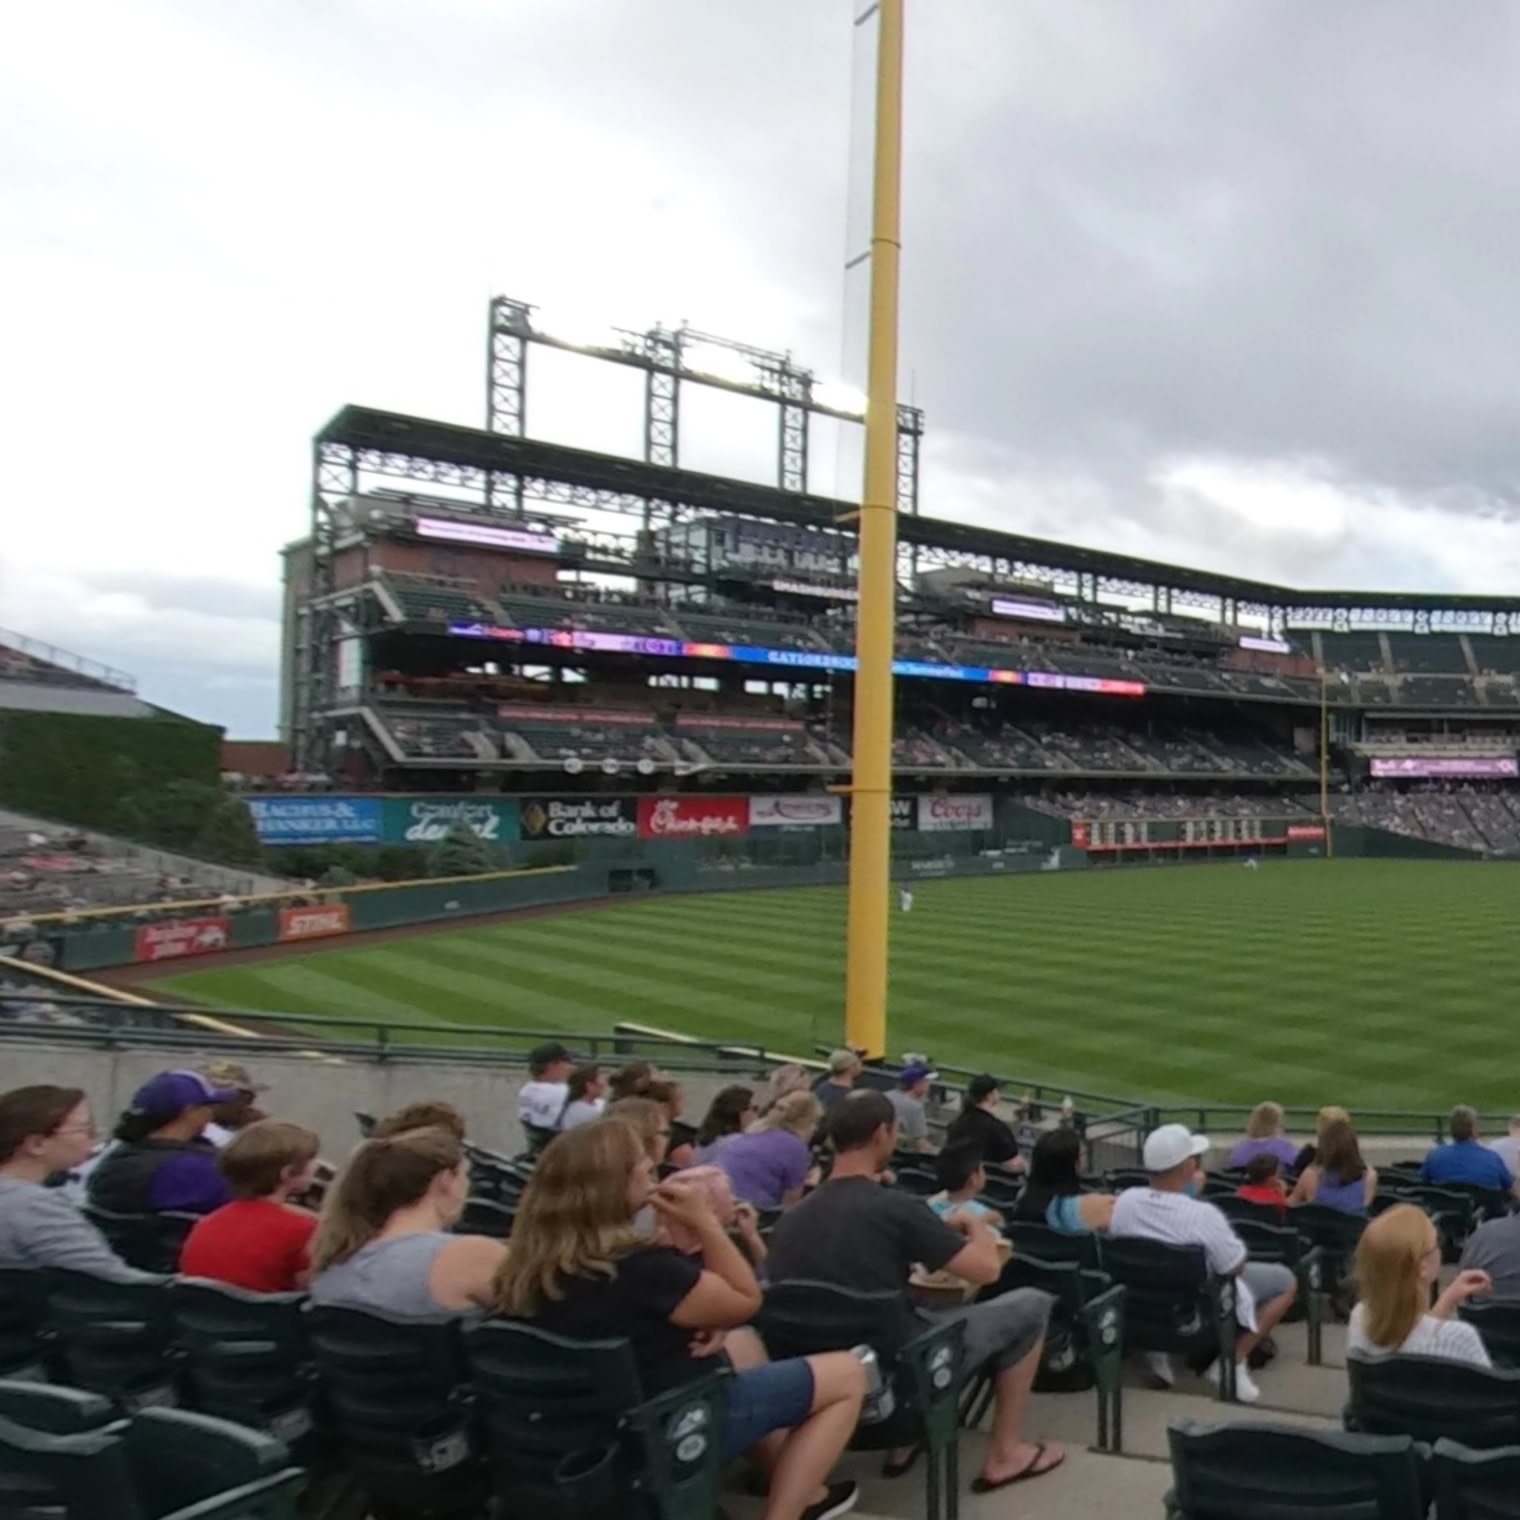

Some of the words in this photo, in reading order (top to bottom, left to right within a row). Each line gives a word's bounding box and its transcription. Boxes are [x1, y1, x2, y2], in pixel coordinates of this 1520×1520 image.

[548, 800, 597, 818] Bank
[599, 799, 622, 818] of
[930, 799, 983, 821] Coors
[547, 816, 635, 836] Colorado
[287, 911, 345, 935] STIHL
